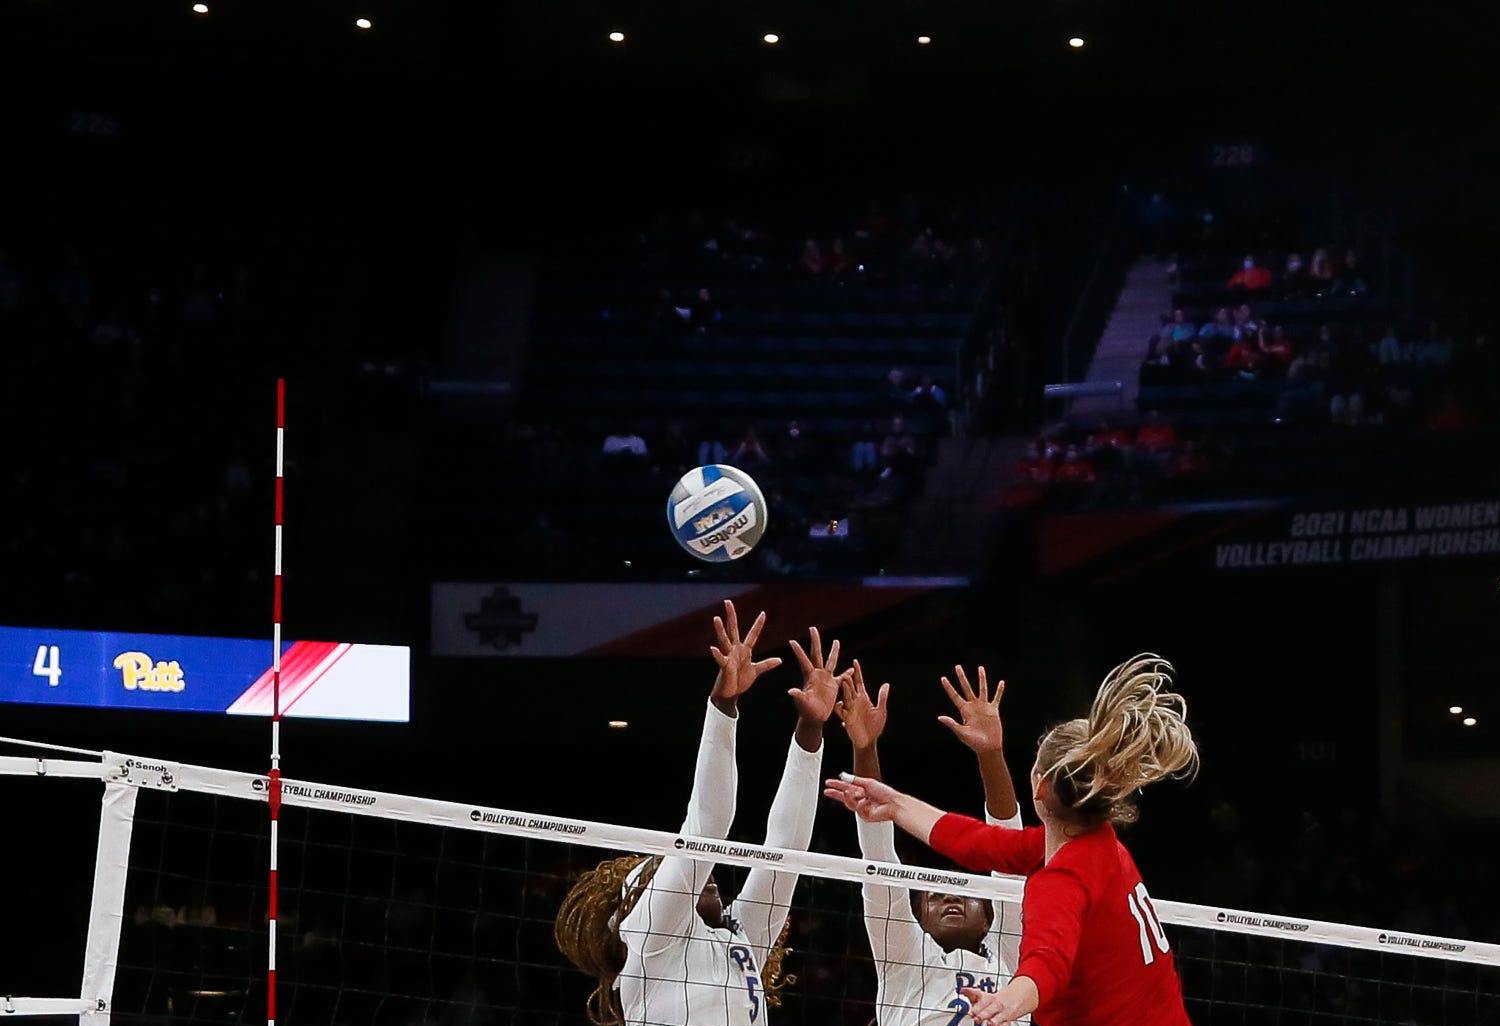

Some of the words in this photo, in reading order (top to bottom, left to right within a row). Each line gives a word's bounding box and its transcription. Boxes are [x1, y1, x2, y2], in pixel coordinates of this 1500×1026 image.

[1291, 510, 1345, 537] 2021
[1349, 506, 1408, 534] NCAA
[1216, 537, 1343, 568] VOLLEYBALL
[32, 644, 62, 687] 4
[112, 651, 185, 693] Pitt
[135, 761, 167, 773] Senoh
[314, 789, 376, 806] CHAMPIONSHIP
[482, 813, 526, 827] VOLLEYBALL
[528, 819, 586, 835] CHAMPIONSHIP
[685, 841, 727, 855] VOLLEYBALL
[728, 847, 784, 861] CHAMPIONSHIP
[876, 867, 916, 880] VOLLEYBALL
[917, 873, 969, 886] CHAMPIONSHIP
[1226, 914, 1262, 927] VOLLEYBALL
[1263, 919, 1310, 932] CHAMPIONSHIP
[1387, 936, 1421, 947] VOLLEYBALL
[1422, 940, 1466, 952] CHAMPIONSHIP
